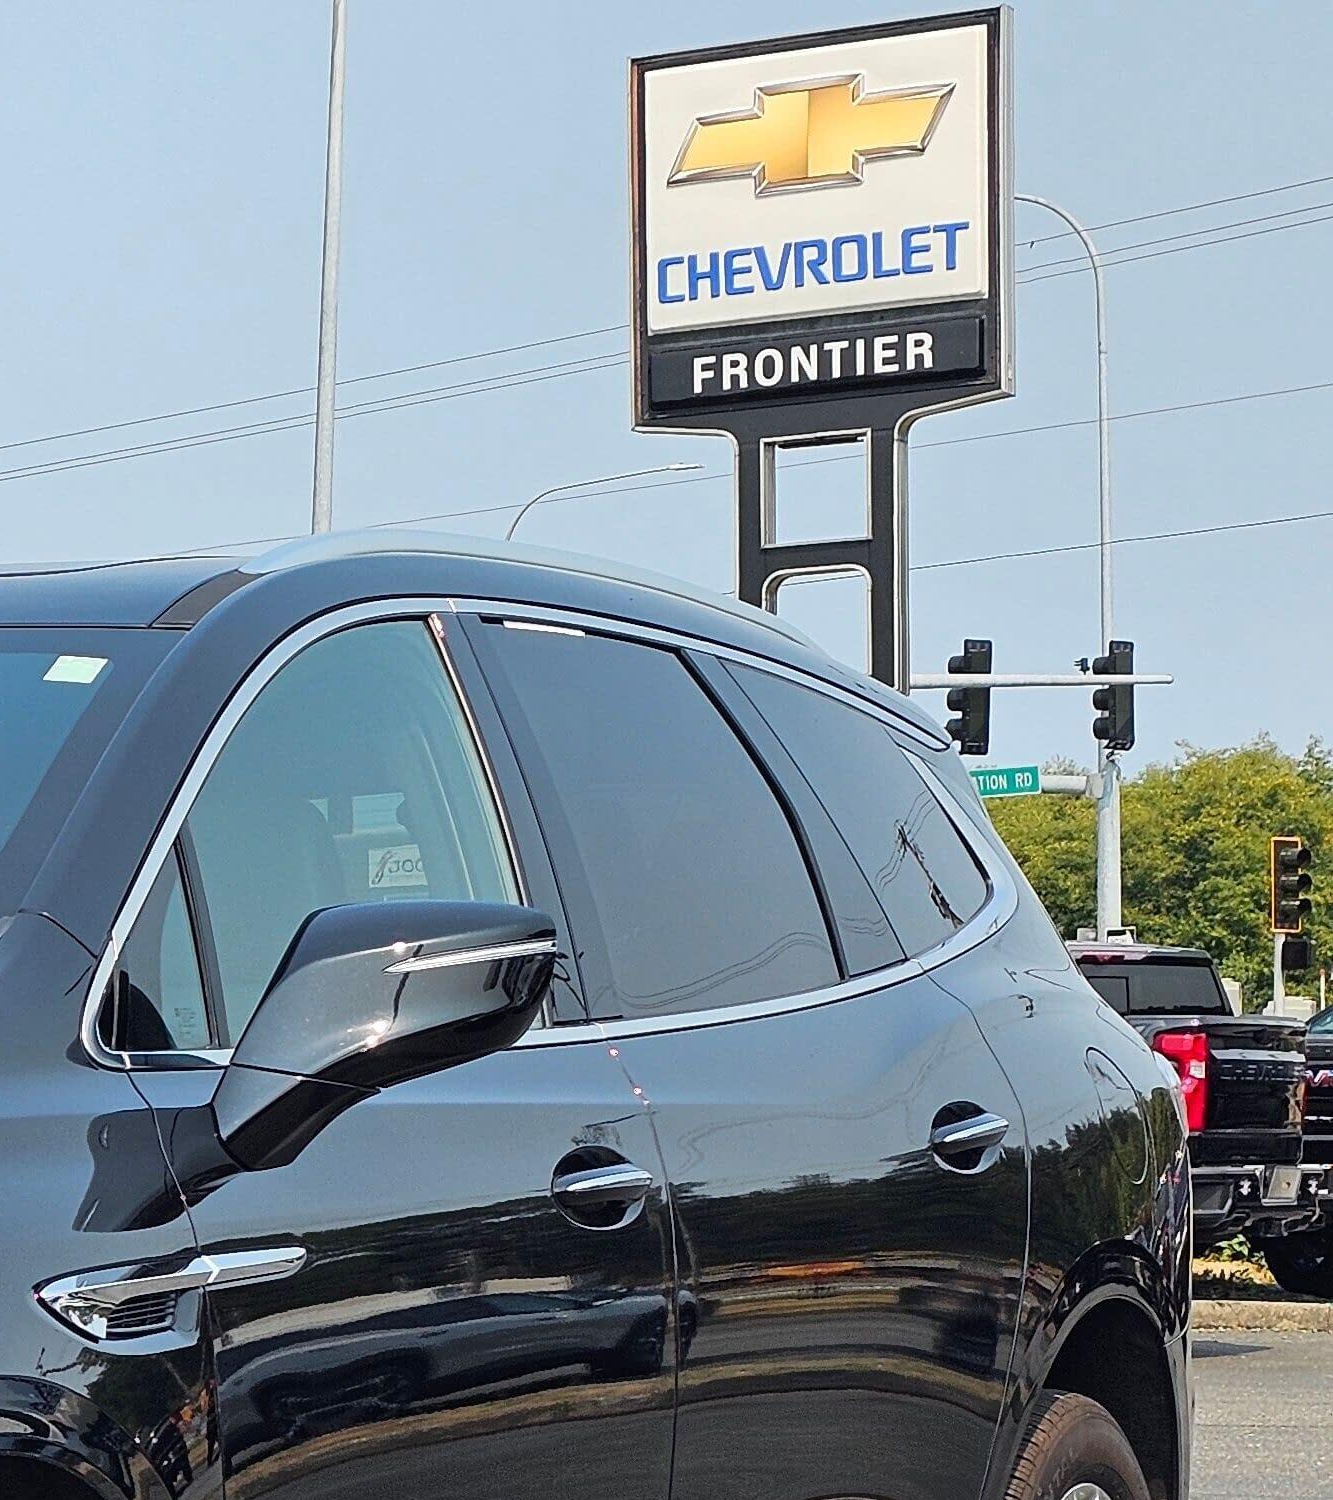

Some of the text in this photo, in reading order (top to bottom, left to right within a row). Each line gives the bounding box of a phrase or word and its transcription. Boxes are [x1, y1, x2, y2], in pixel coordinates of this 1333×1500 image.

[656, 221, 970, 304] CHEVROLET
[692, 332, 934, 394] FRONTIER
[973, 771, 1033, 791] TION RD
